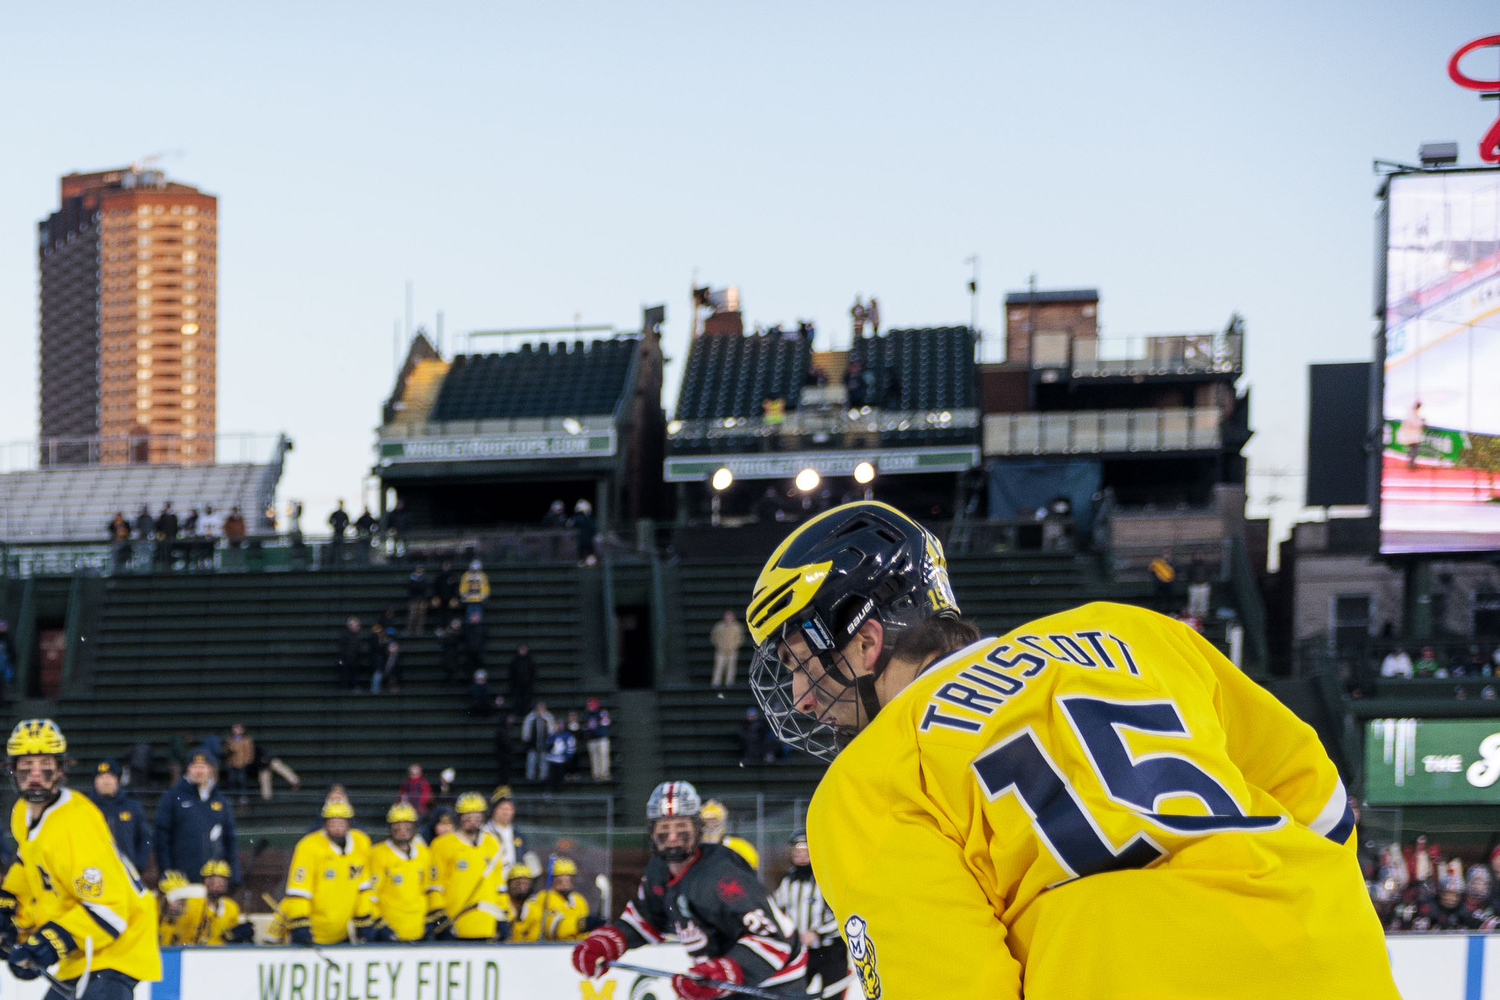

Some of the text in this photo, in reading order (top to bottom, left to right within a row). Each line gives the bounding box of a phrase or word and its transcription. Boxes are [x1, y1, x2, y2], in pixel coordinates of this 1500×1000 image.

[918, 630, 1141, 733] TRUSCOTT
[969, 693, 1289, 888] 15
[850, 939, 863, 954] M
